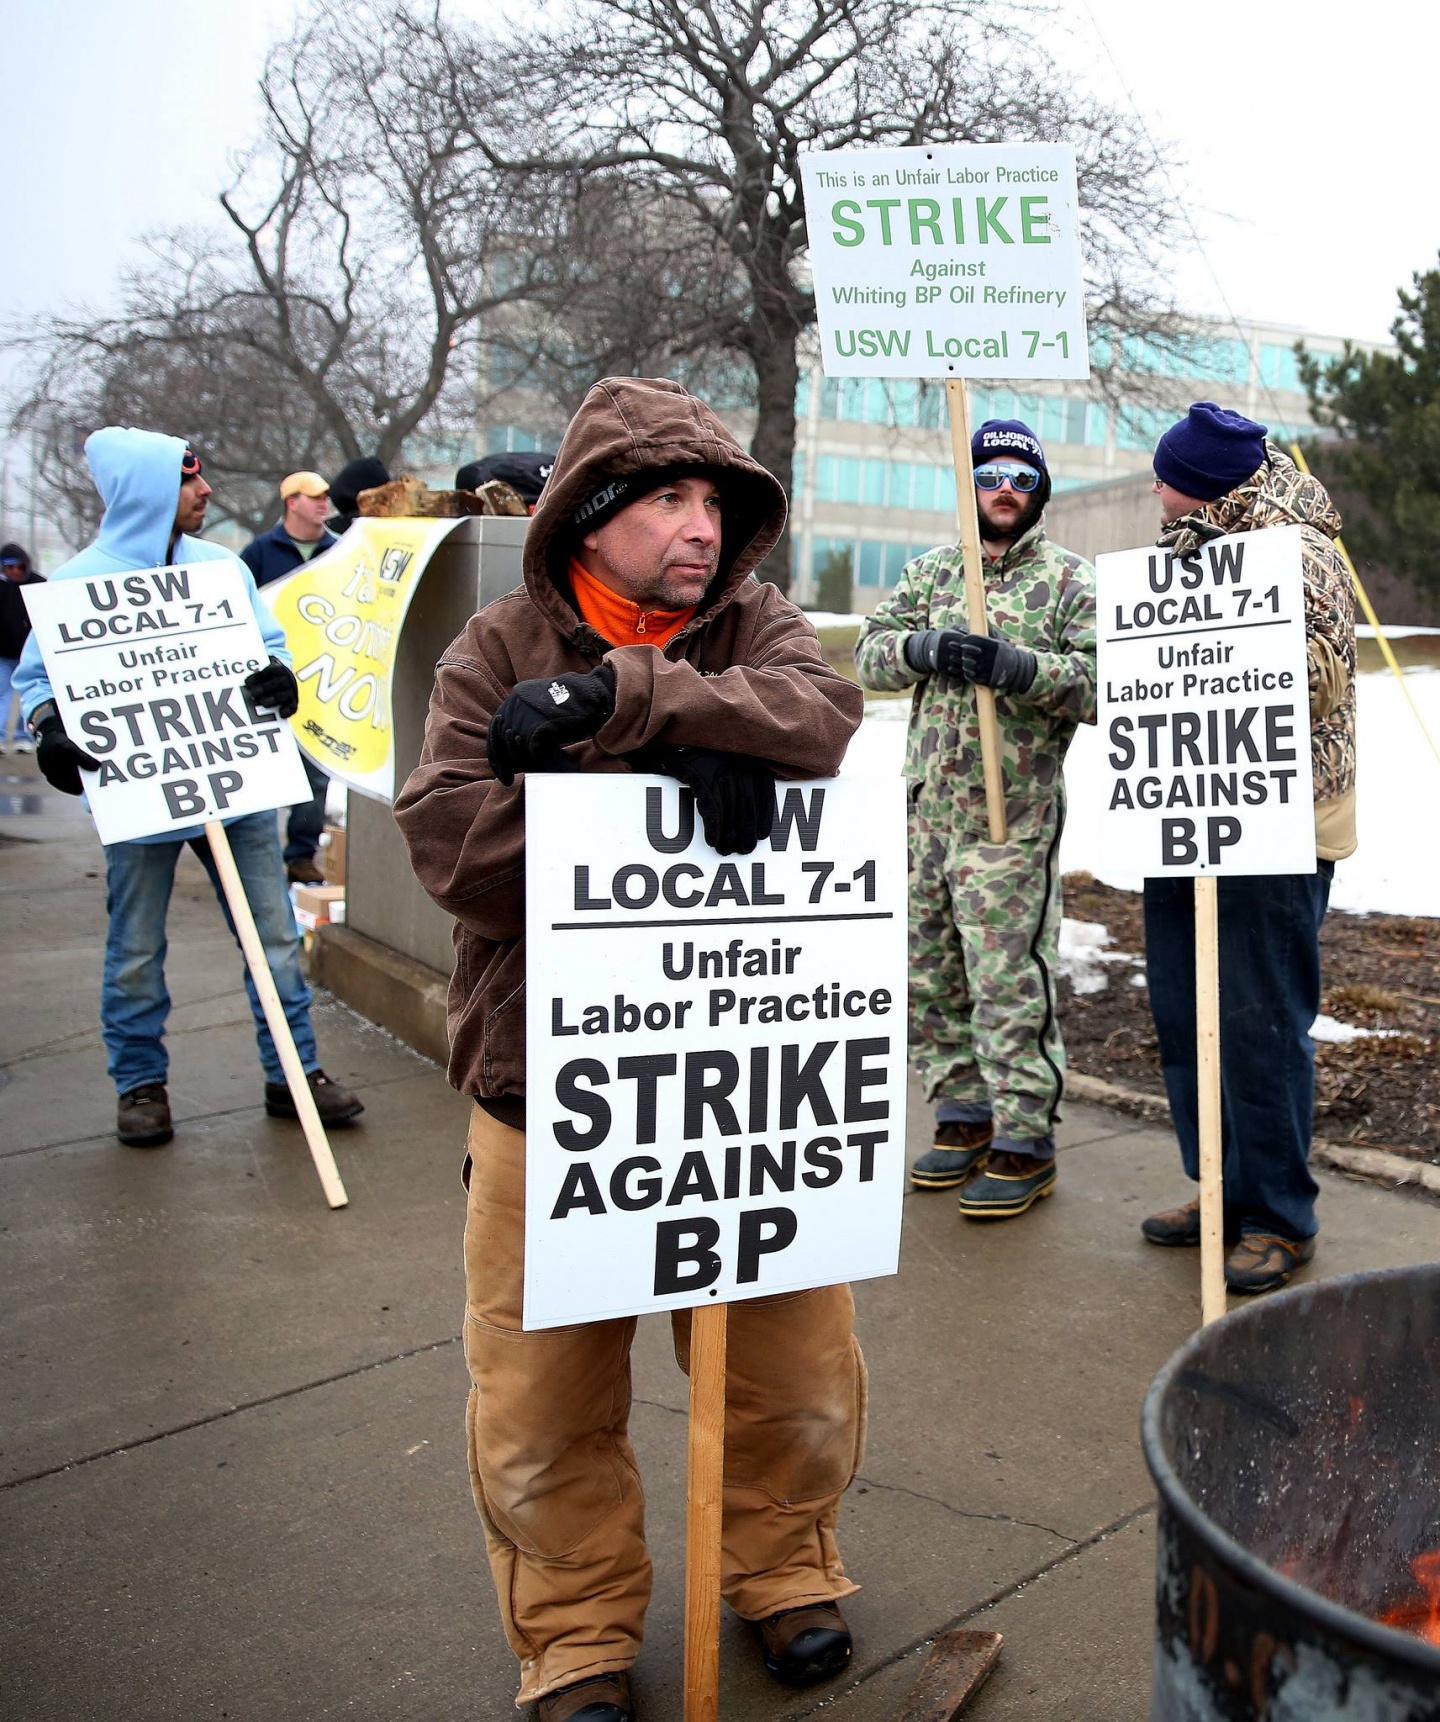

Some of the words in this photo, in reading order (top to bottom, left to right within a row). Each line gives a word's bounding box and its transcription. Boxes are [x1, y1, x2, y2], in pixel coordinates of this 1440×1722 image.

[816, 172, 847, 188] This
[853, 171, 866, 187] is
[872, 173, 890, 186] an
[895, 168, 941, 185] Unfair
[947, 167, 990, 185] Labor
[996, 166, 1059, 183] Practice
[831, 196, 1052, 247] STRIKE
[909, 259, 986, 281] Against
[832, 286, 907, 308] Whiting
[915, 286, 942, 304] BP
[949, 285, 974, 304] Oil
[983, 285, 1067, 308] Refinery
[834, 329, 911, 358] USW
[926, 330, 1009, 358] Local
[1021, 330, 1069, 359] 7-1
[983, 439, 1029, 451] LOCAL
[85, 570, 191, 611] USW
[1148, 542, 1245, 594] USW
[58, 608, 180, 643] LOCAL
[185, 599, 234, 624] 7-1
[1115, 594, 1223, 631] LOCAL
[1232, 585, 1280, 617] 7-1
[118, 643, 198, 669] Unfair
[1158, 641, 1234, 669] Unfair
[66, 677, 144, 702] Labor
[151, 658, 260, 687] Practice
[1106, 678, 1174, 703] Labor
[1183, 668, 1294, 697] Practice
[99, 727, 281, 788] AGAINST
[1108, 704, 1297, 771] STRIKE
[161, 770, 244, 820] BP
[1109, 769, 1297, 811] AGAINST
[646, 787, 826, 854] UW
[1161, 816, 1242, 866] BP
[574, 862, 785, 910] LOCAL
[801, 860, 876, 903] 7-1
[663, 938, 802, 981] Unfair
[551, 994, 693, 1036] Labor
[708, 982, 892, 1027] Practice
[552, 1037, 890, 1152] STRIKE
[550, 1130, 889, 1219] AGAINST
[653, 1207, 798, 1296] BP
